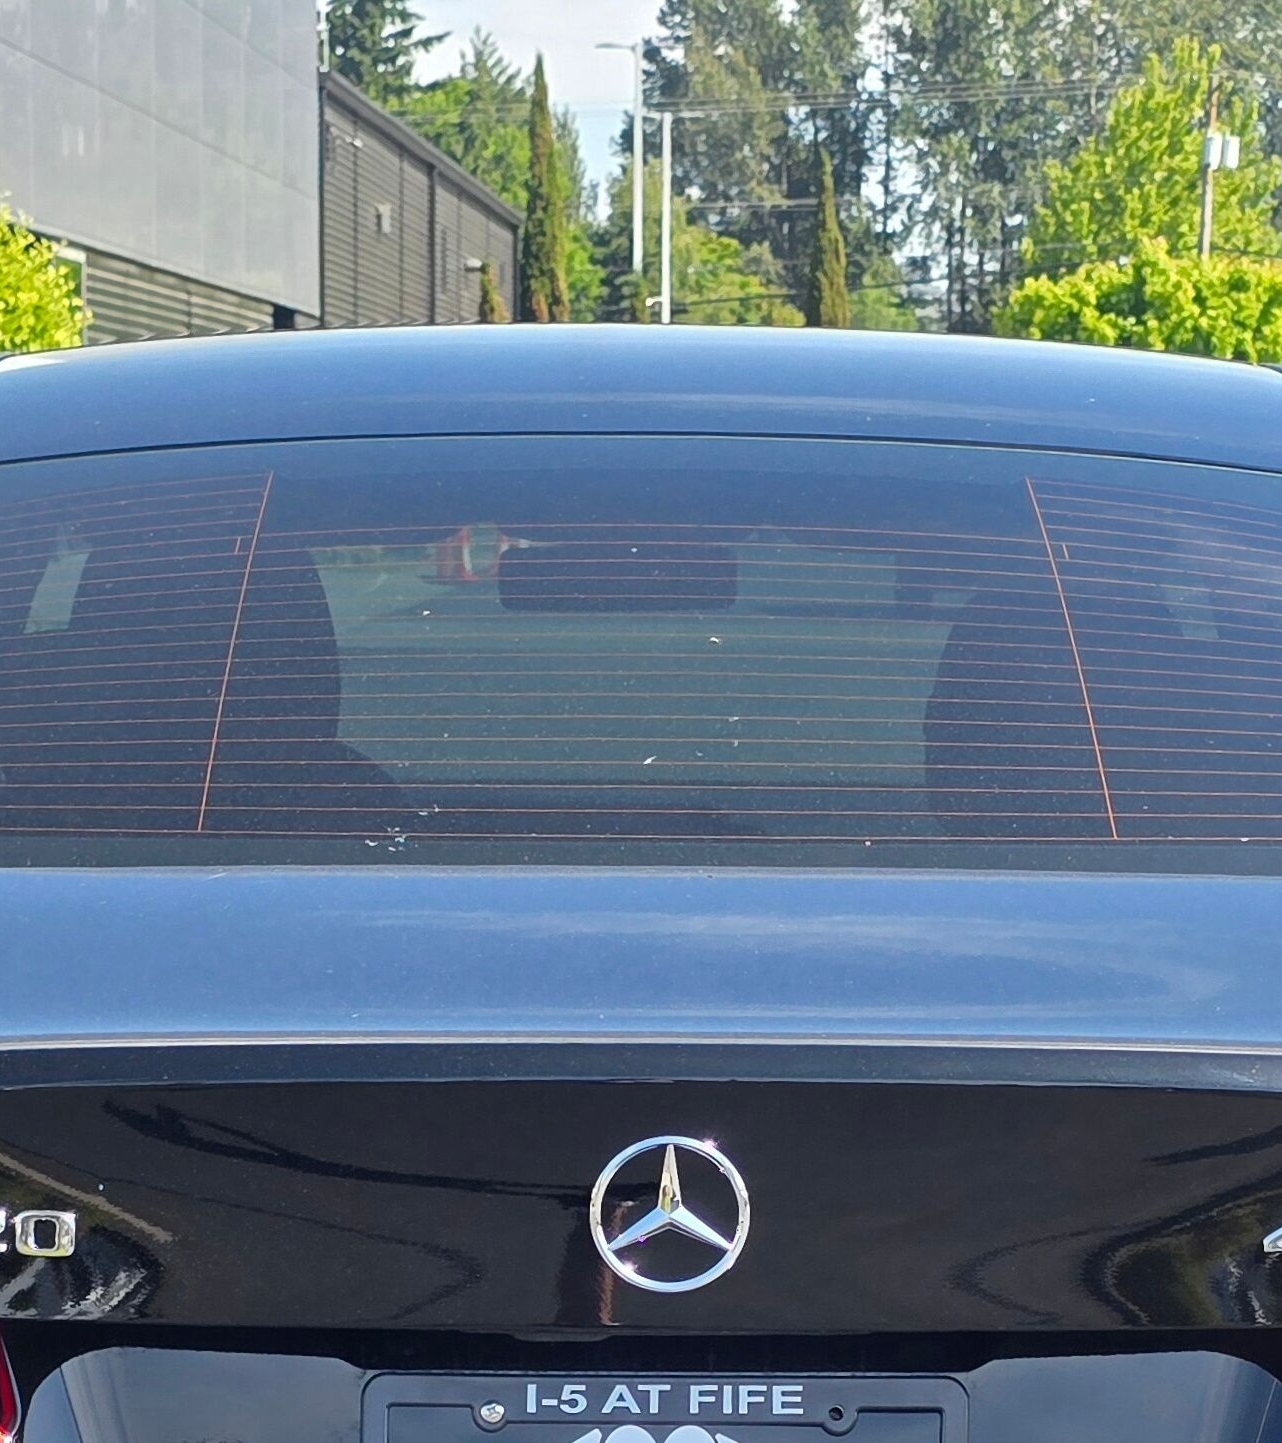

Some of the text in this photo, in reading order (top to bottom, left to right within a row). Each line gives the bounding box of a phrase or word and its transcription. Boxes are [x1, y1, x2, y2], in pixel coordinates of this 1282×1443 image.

[526, 1384, 804, 1415] I-5 AT FIFE
